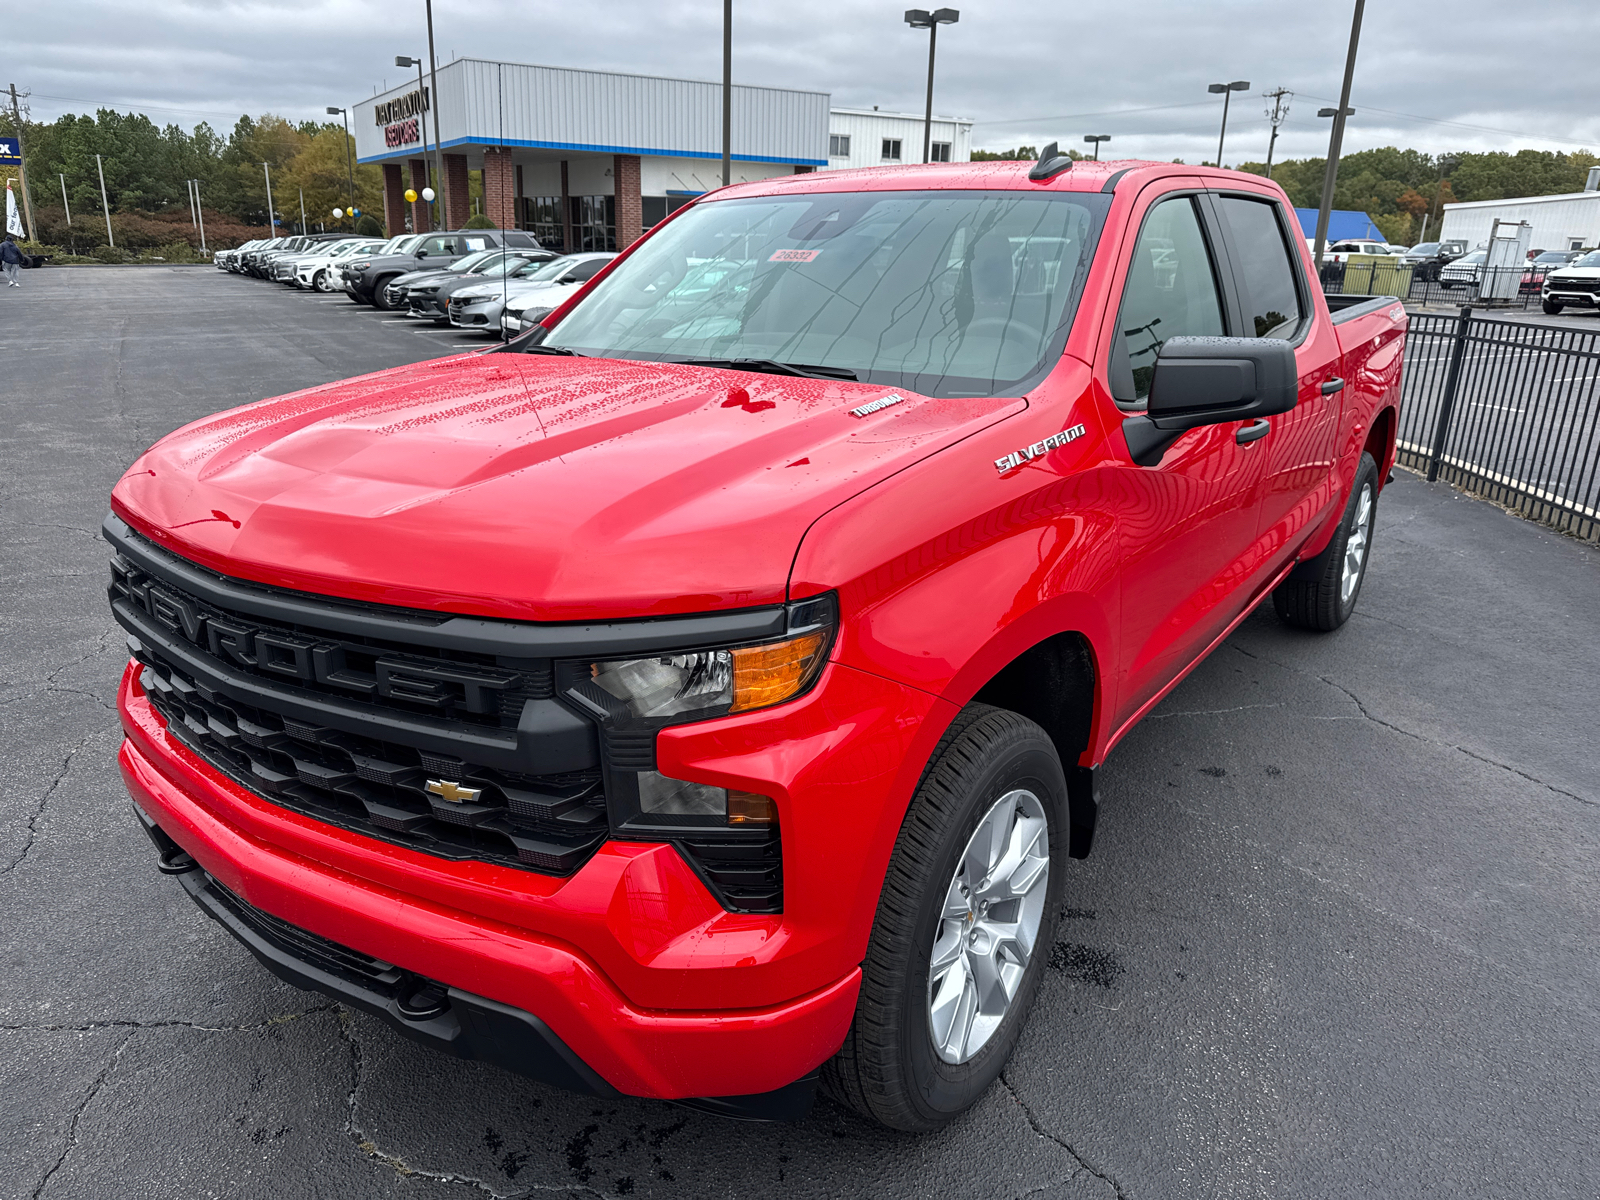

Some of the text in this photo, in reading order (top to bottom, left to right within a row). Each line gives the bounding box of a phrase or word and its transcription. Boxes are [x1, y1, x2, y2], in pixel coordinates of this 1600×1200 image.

[384, 118, 419, 147] USED CARS
[776, 251, 812, 260] 26332
[850, 393, 905, 417] TURBOMAX
[994, 423, 1086, 474] SILVERADO
[109, 555, 523, 713] CHEVROLET
